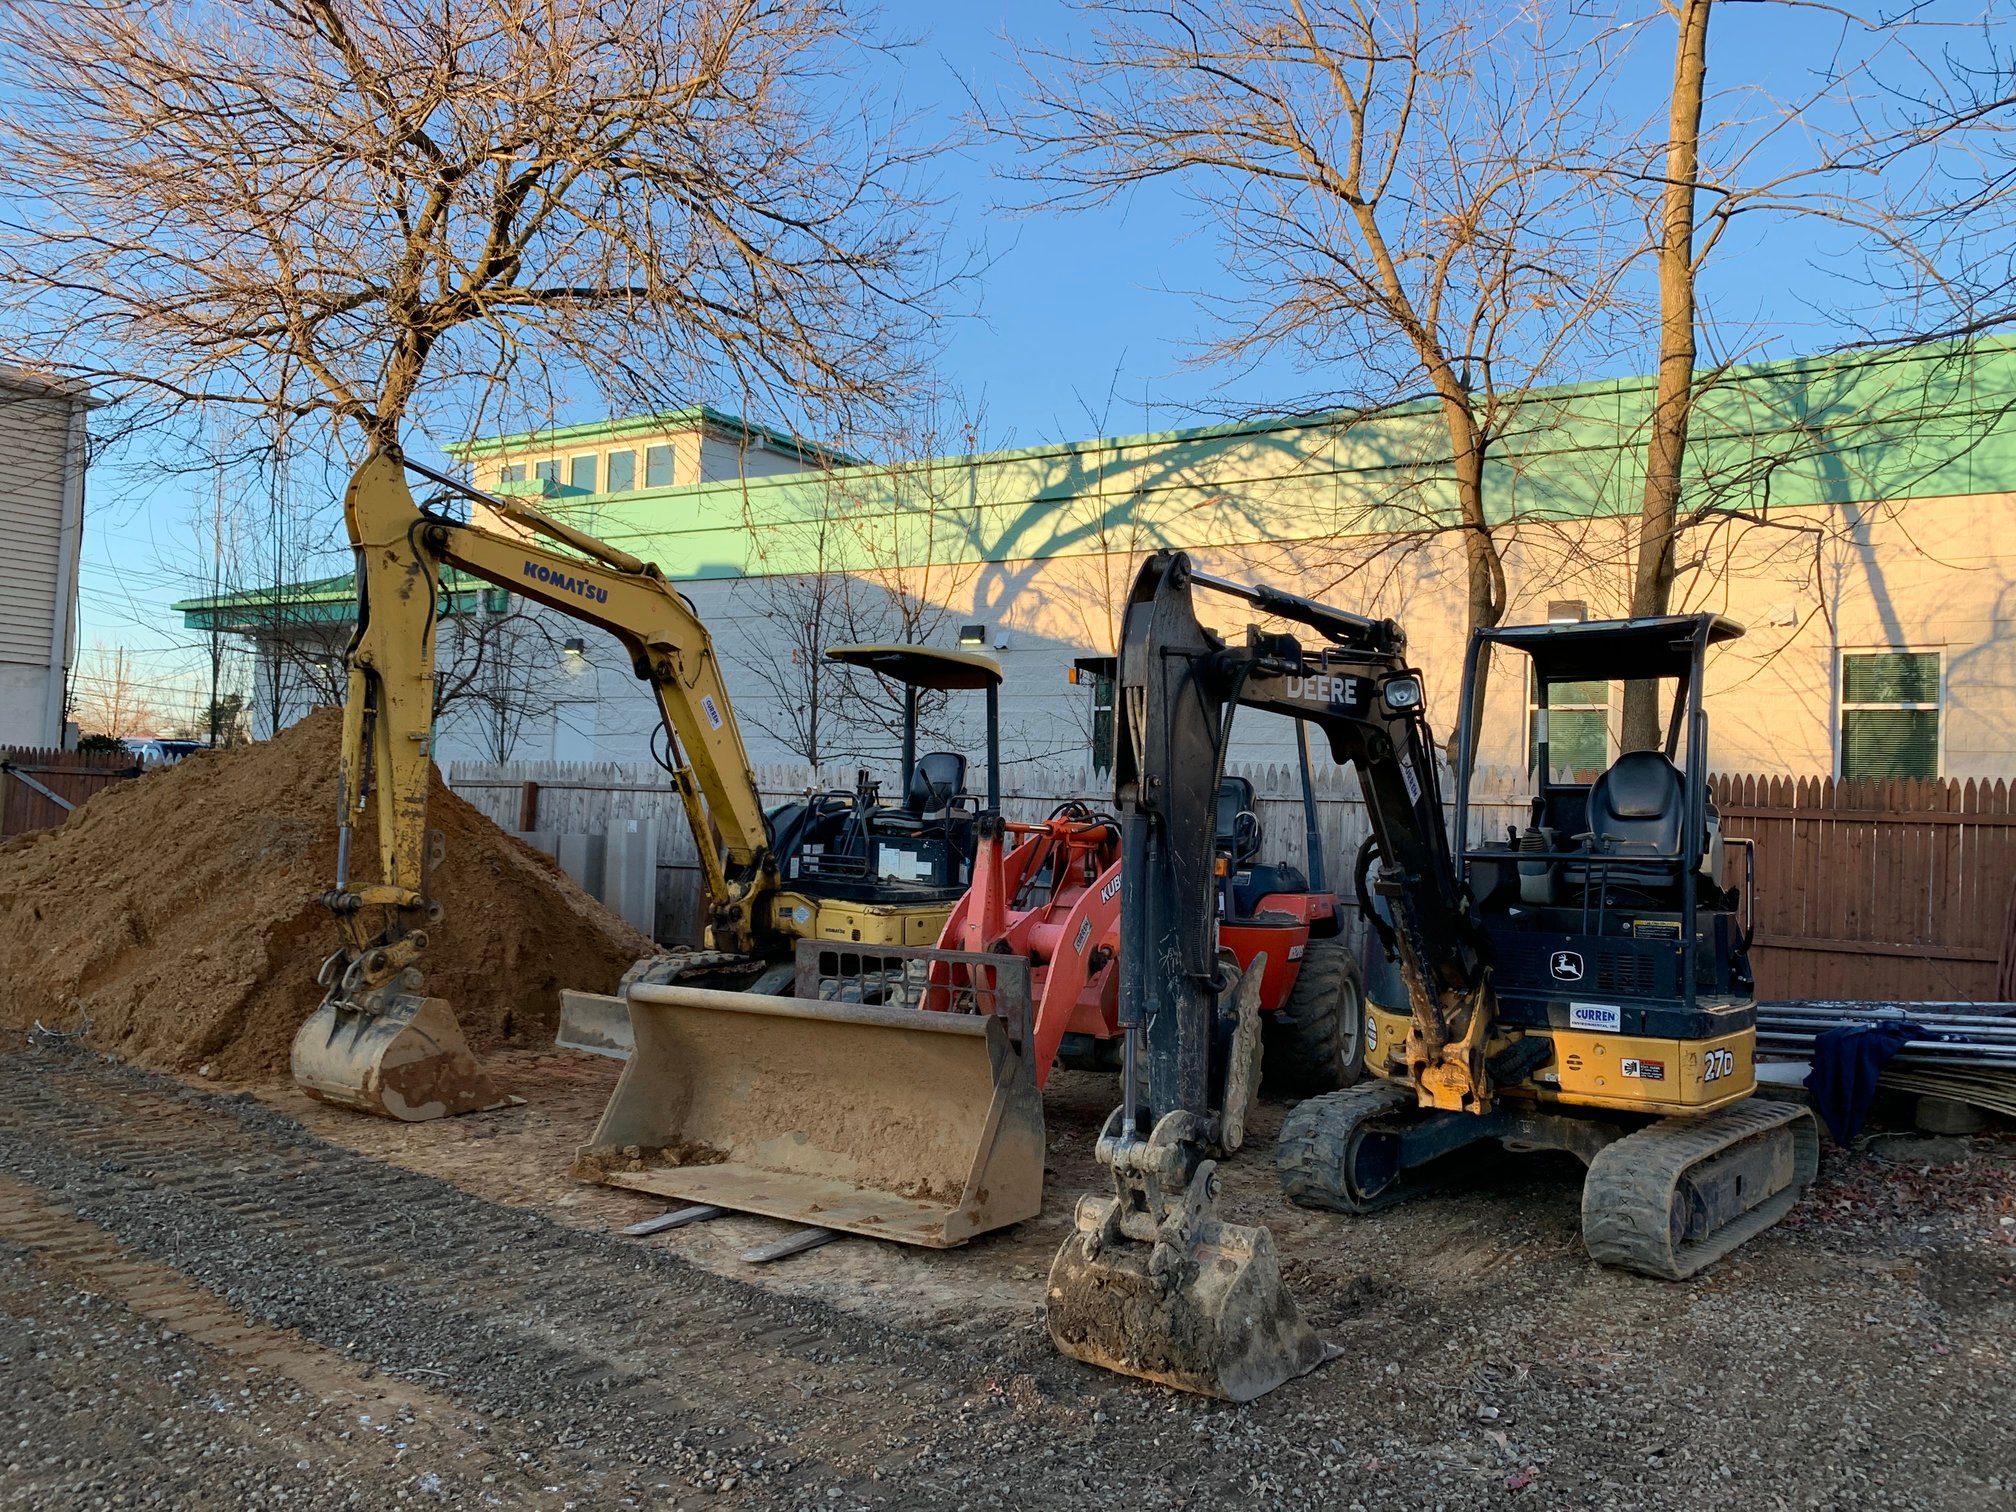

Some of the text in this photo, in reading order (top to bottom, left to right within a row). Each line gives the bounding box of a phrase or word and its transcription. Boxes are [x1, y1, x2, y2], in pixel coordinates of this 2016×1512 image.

[523, 560, 608, 604] KOMATSU
[1287, 675, 1357, 704] DEERE
[706, 699, 719, 724] CURREN
[1101, 873, 1122, 904] KUB
[1076, 921, 1089, 948] CURREN
[1575, 1009, 1615, 1021] CURREN
[1704, 1048, 1735, 1082] 27D
